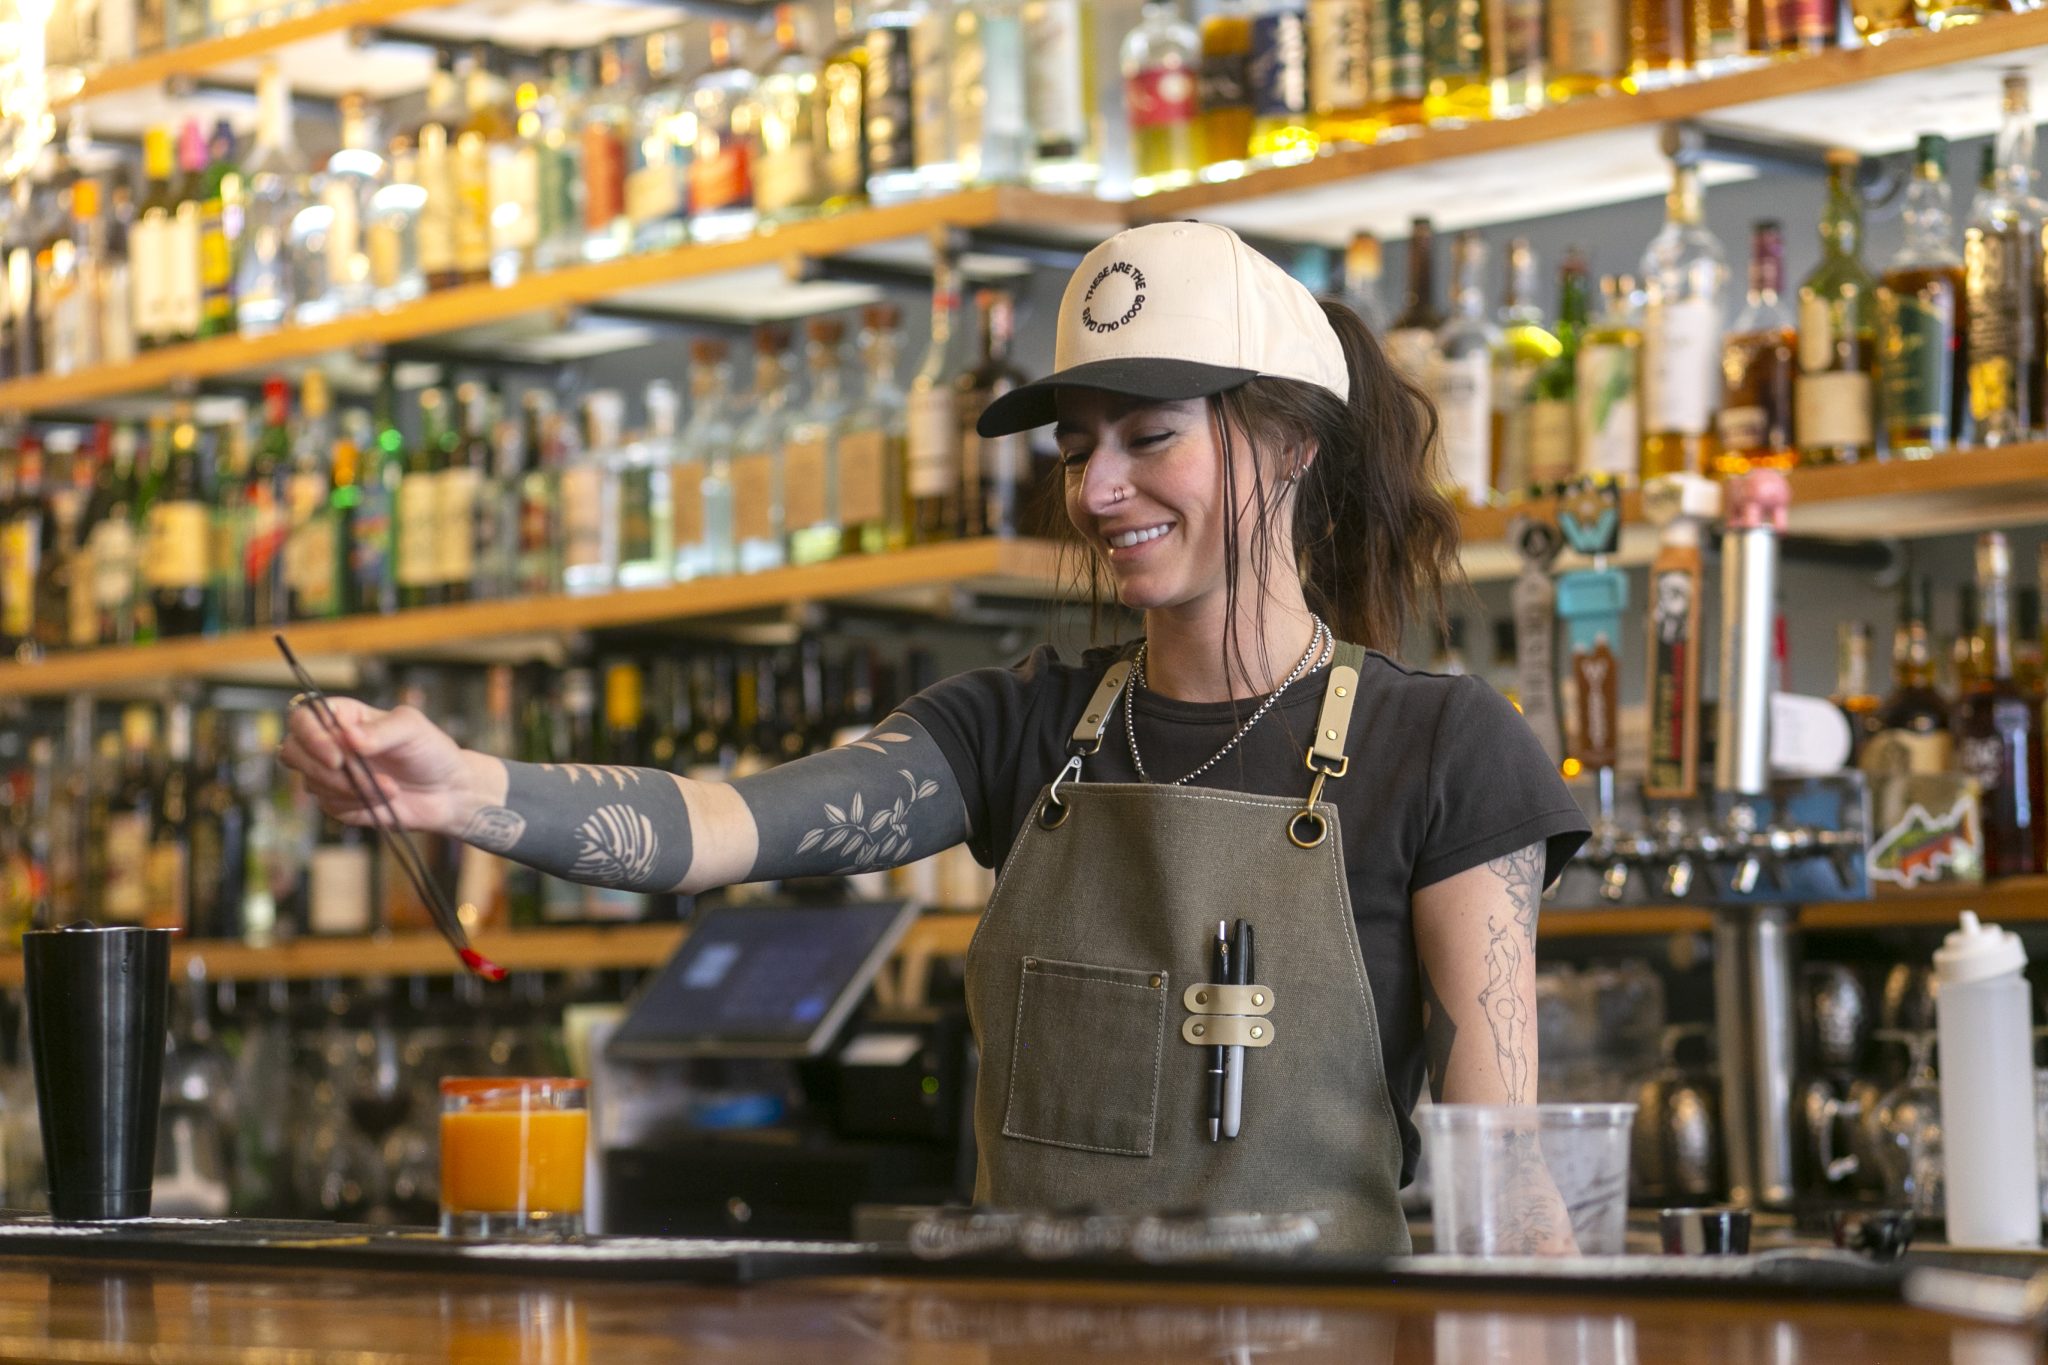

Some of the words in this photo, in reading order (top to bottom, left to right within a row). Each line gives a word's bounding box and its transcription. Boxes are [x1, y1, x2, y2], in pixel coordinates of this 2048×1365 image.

[1111, 262, 1132, 275] ARE
[1130, 267, 1146, 291] THE
[1085, 266, 1110, 302] THESE
[1082, 307, 1098, 331] DAYS
[1120, 294, 1145, 325] GOOD
[1097, 320, 1119, 333] OLD
